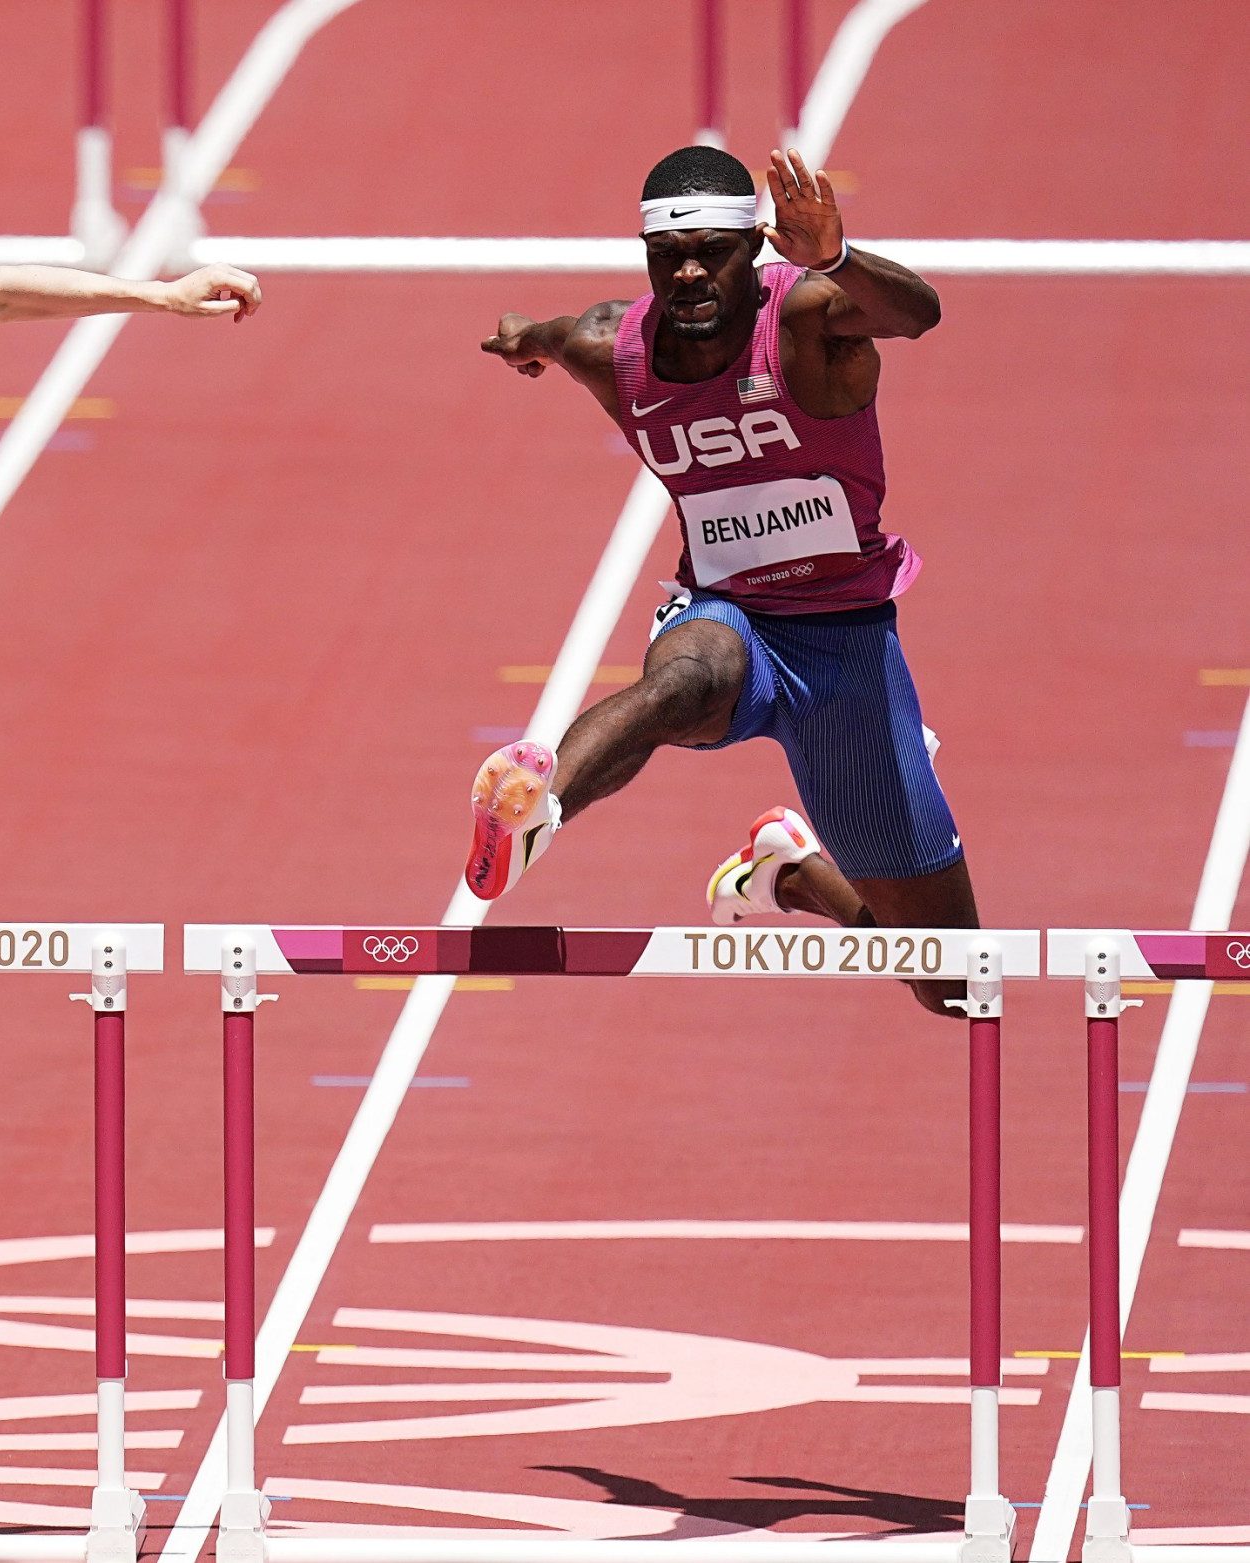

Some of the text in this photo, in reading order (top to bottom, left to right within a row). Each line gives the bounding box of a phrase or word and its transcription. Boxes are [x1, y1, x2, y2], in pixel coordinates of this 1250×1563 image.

[636, 409, 801, 476] USA
[701, 496, 833, 545] BENJAMIN
[746, 570, 790, 586] TOKYO 2020
[684, 933, 942, 973] TOKYO 2020
